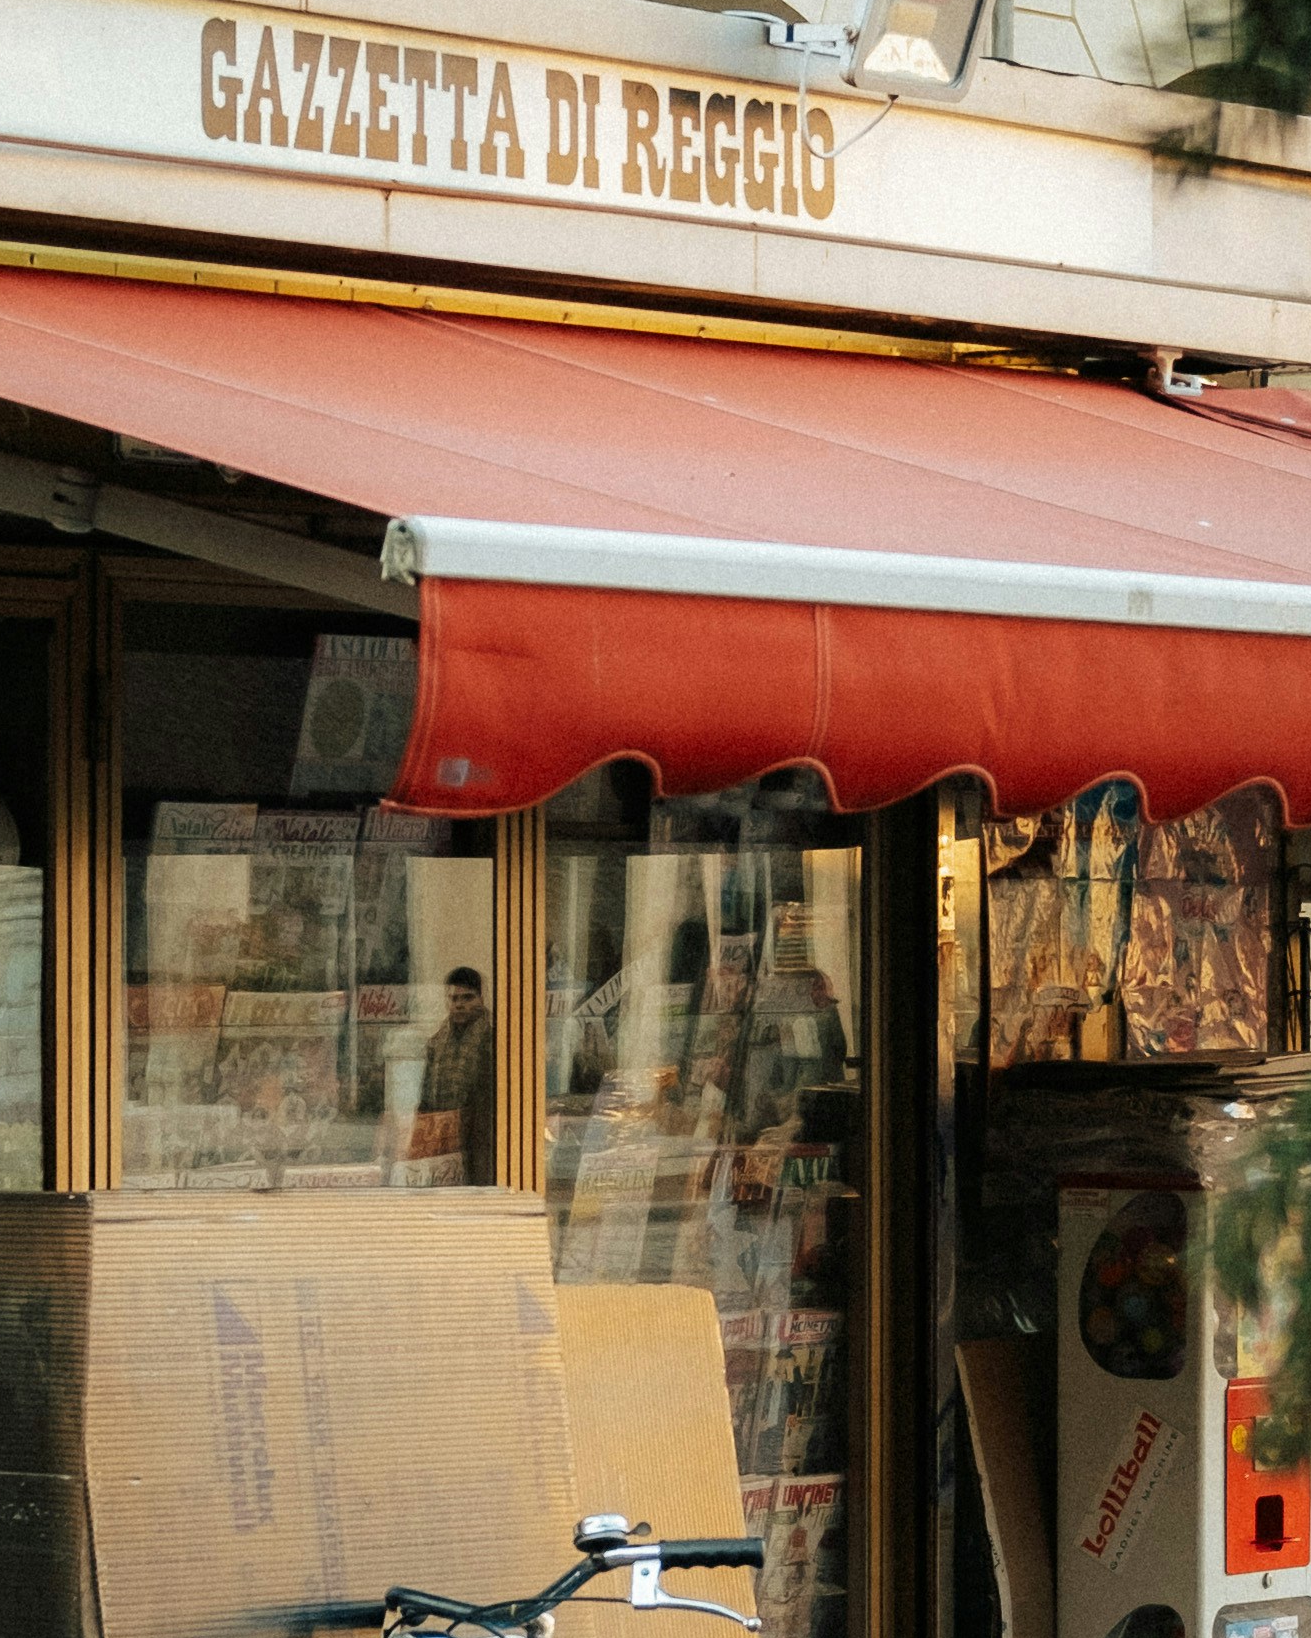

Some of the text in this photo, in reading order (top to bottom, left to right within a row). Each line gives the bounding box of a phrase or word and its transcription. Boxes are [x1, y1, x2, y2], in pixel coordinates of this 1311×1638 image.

[200, 16, 836, 221] GAZZETTA DI REGGIO
[1082, 1411, 1163, 1559] Lolliball
[1142, 1430, 1180, 1502] MACHINE
